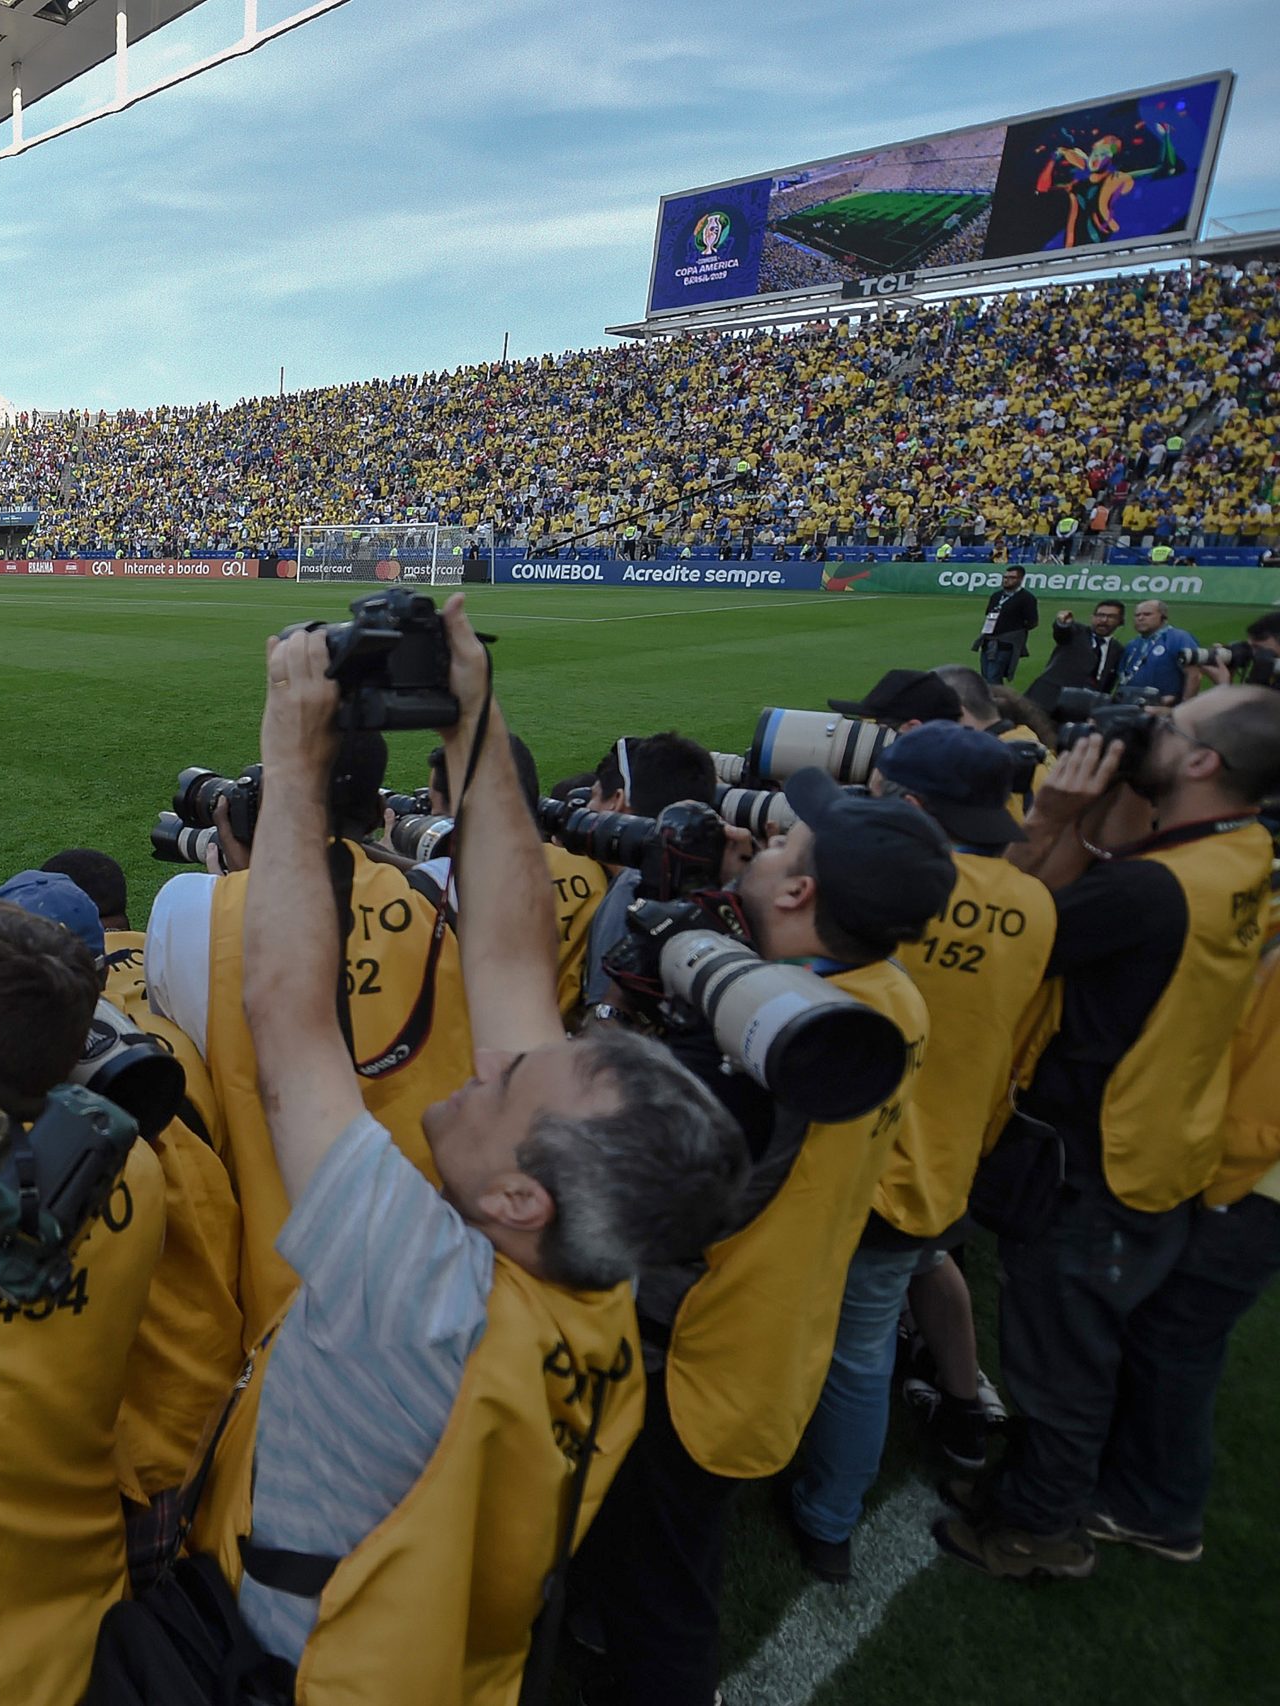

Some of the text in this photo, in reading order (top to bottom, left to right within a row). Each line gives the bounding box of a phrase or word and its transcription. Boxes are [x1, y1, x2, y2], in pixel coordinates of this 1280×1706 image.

[674, 266, 698, 277] COPA
[699, 258, 739, 273] AMERICA
[859, 274, 914, 296] TCL
[28, 561, 53, 573] BRAHMA
[92, 561, 114, 575] GOL
[124, 561, 210, 575] Internet a bordo
[222, 561, 248, 576] GOL
[301, 563, 352, 574] mastercard
[404, 564, 464, 575] mastrcard
[511, 563, 786, 588] CONMEBOL Acredite sempre.
[938, 568, 1203, 594] copamerica.com
[923, 937, 986, 974] 152
